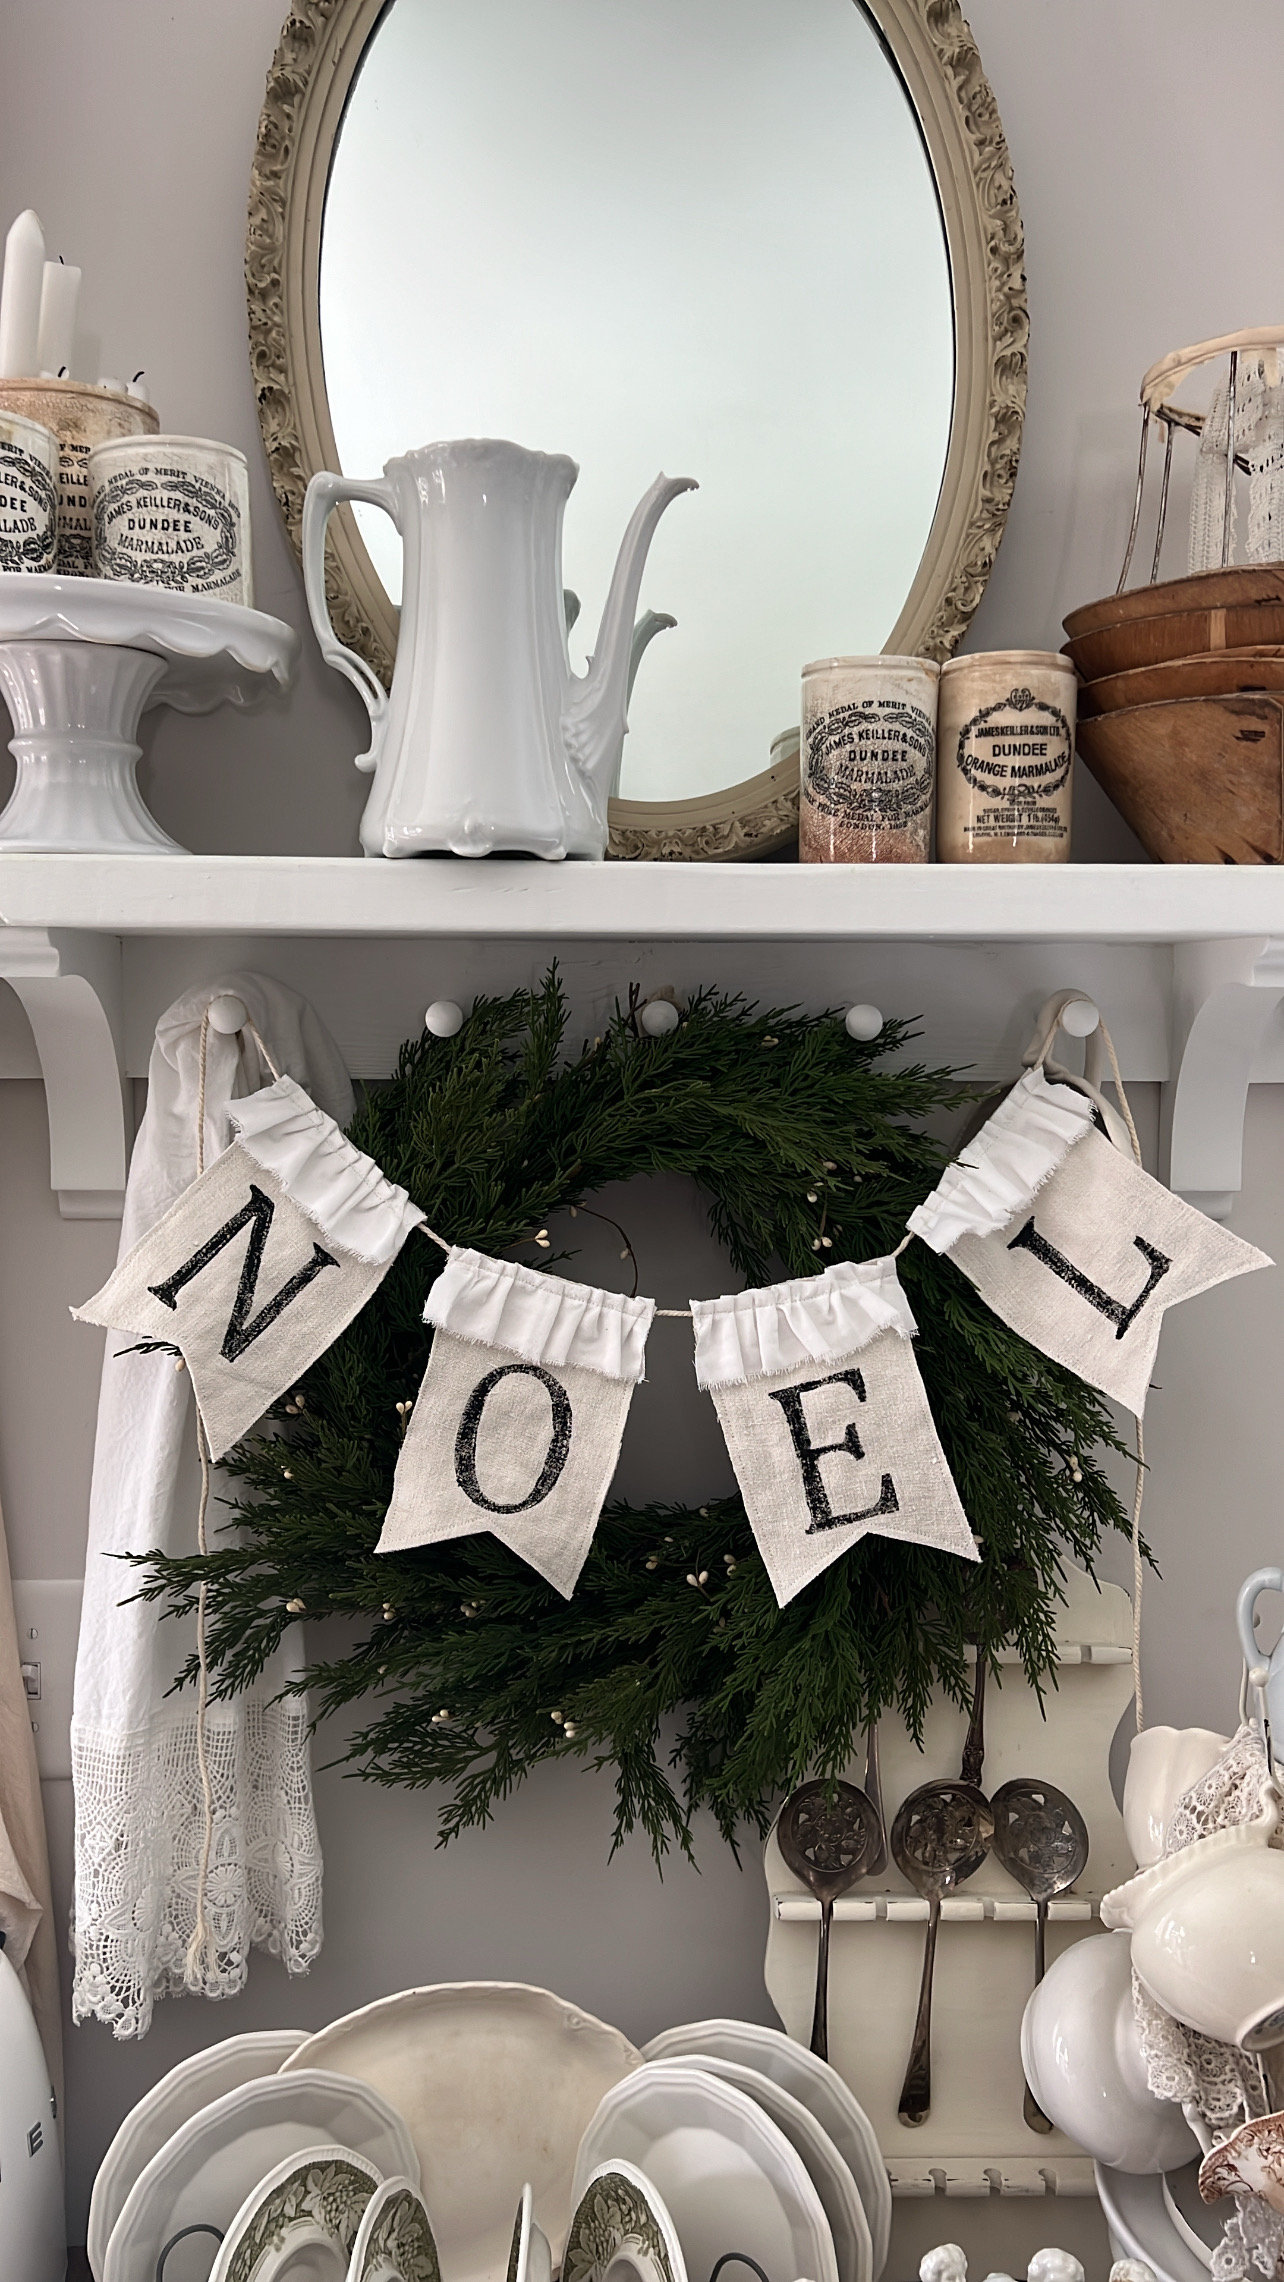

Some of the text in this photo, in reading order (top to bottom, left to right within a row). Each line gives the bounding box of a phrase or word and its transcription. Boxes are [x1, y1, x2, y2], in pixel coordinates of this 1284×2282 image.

[108, 469, 134, 485] MEDAL
[139, 467, 150, 476] OF
[155, 467, 187, 479] MERIT
[107, 501, 133, 525] JAMES
[128, 518, 192, 533] DUNDEE
[118, 533, 204, 555] MARMALADE
[828, 702, 859, 719] MEDAL
[862, 700, 874, 709] OF
[877, 700, 907, 710] MERIT
[975, 727, 1000, 738] JAMES
[825, 732, 855, 756] JAMES
[992, 743, 1048, 757] DUNDEE
[848, 749, 908, 761] DUNDEE
[837, 763, 916, 784] MARMALADE
[965, 751, 1067, 779] ORANGE MARMALADE
[842, 811, 876, 822] MEDAL
[976, 815, 990, 824] NET
[993, 814, 1022, 823] WEIGT
